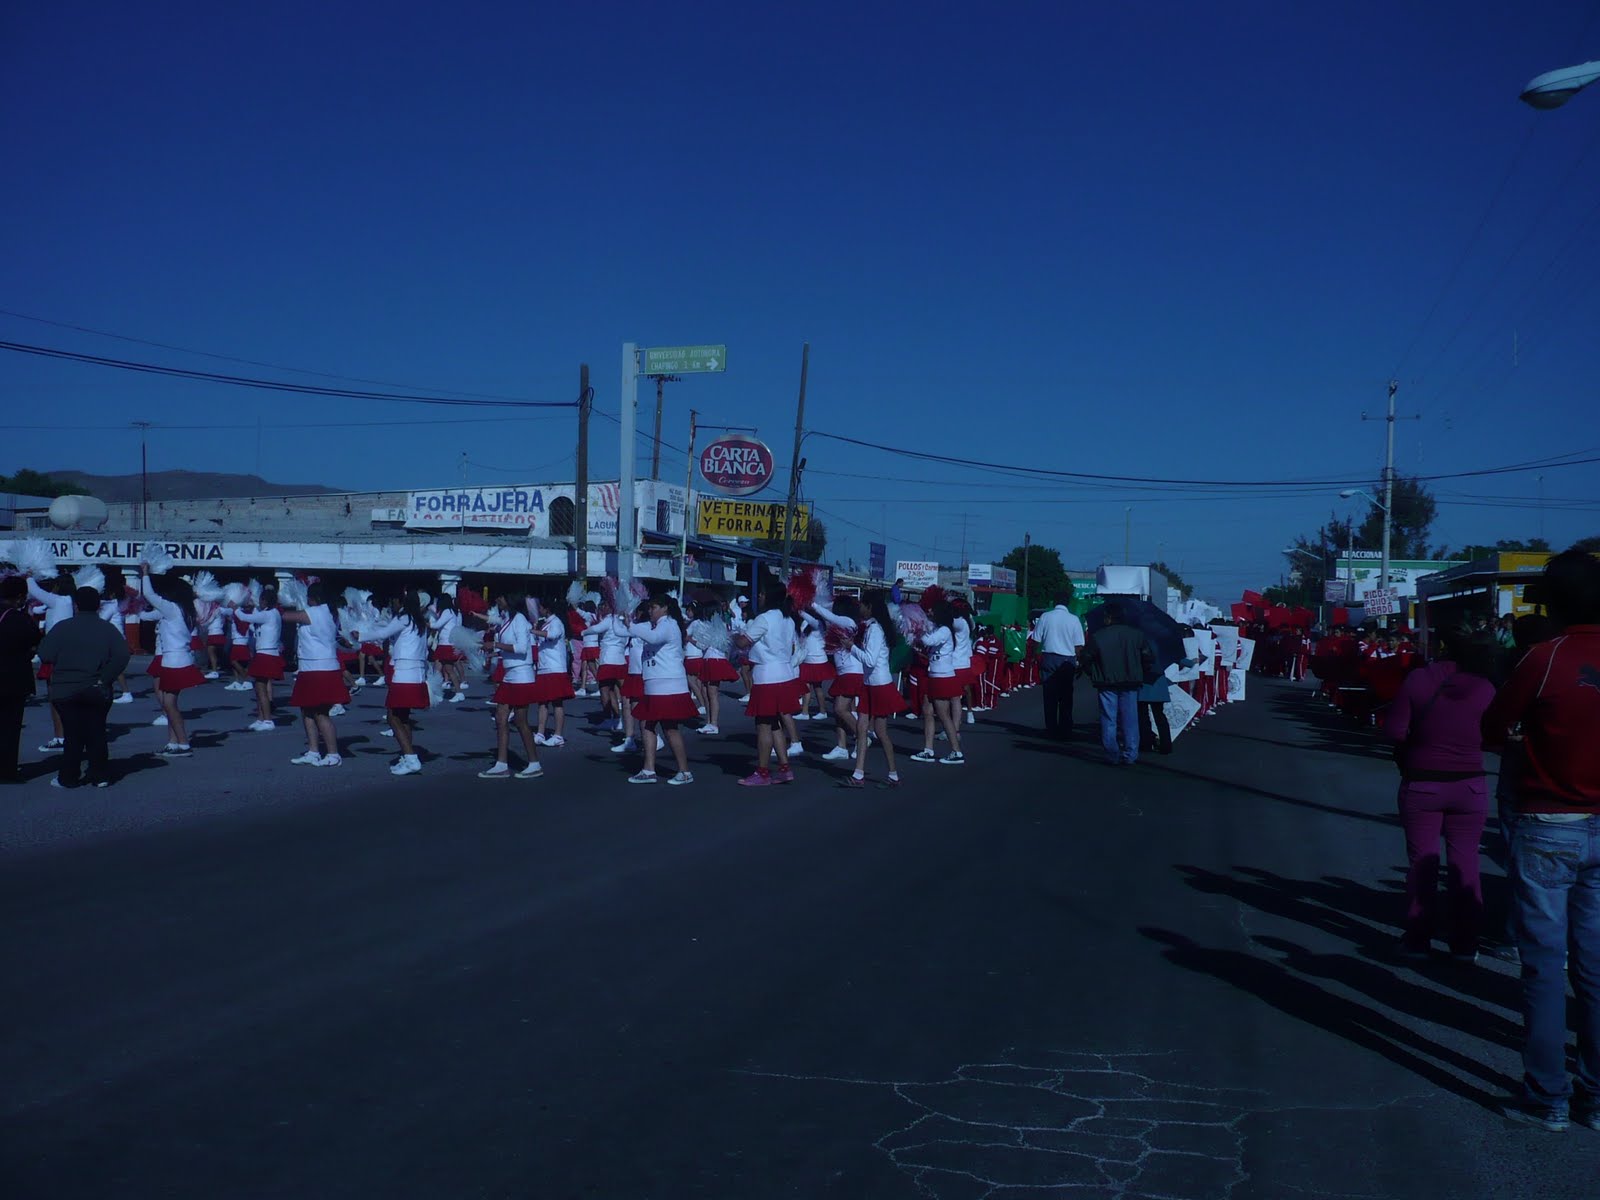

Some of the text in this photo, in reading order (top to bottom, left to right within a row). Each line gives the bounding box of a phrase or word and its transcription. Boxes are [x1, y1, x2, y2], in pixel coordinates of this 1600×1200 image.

[649, 350, 686, 360] UNIVERSIDAD
[650, 361, 679, 371] CHAPINGO
[709, 445, 761, 462] CARTA
[704, 458, 766, 475] BLANCA
[415, 489, 545, 513] FORRAJERA
[703, 501, 802, 518] VETERINARA
[703, 517, 802, 534] Y FORRAEA
[898, 563, 922, 571] POLLOS
[1364, 590, 1383, 599] RICO
[1365, 604, 1393, 615] ASADO
